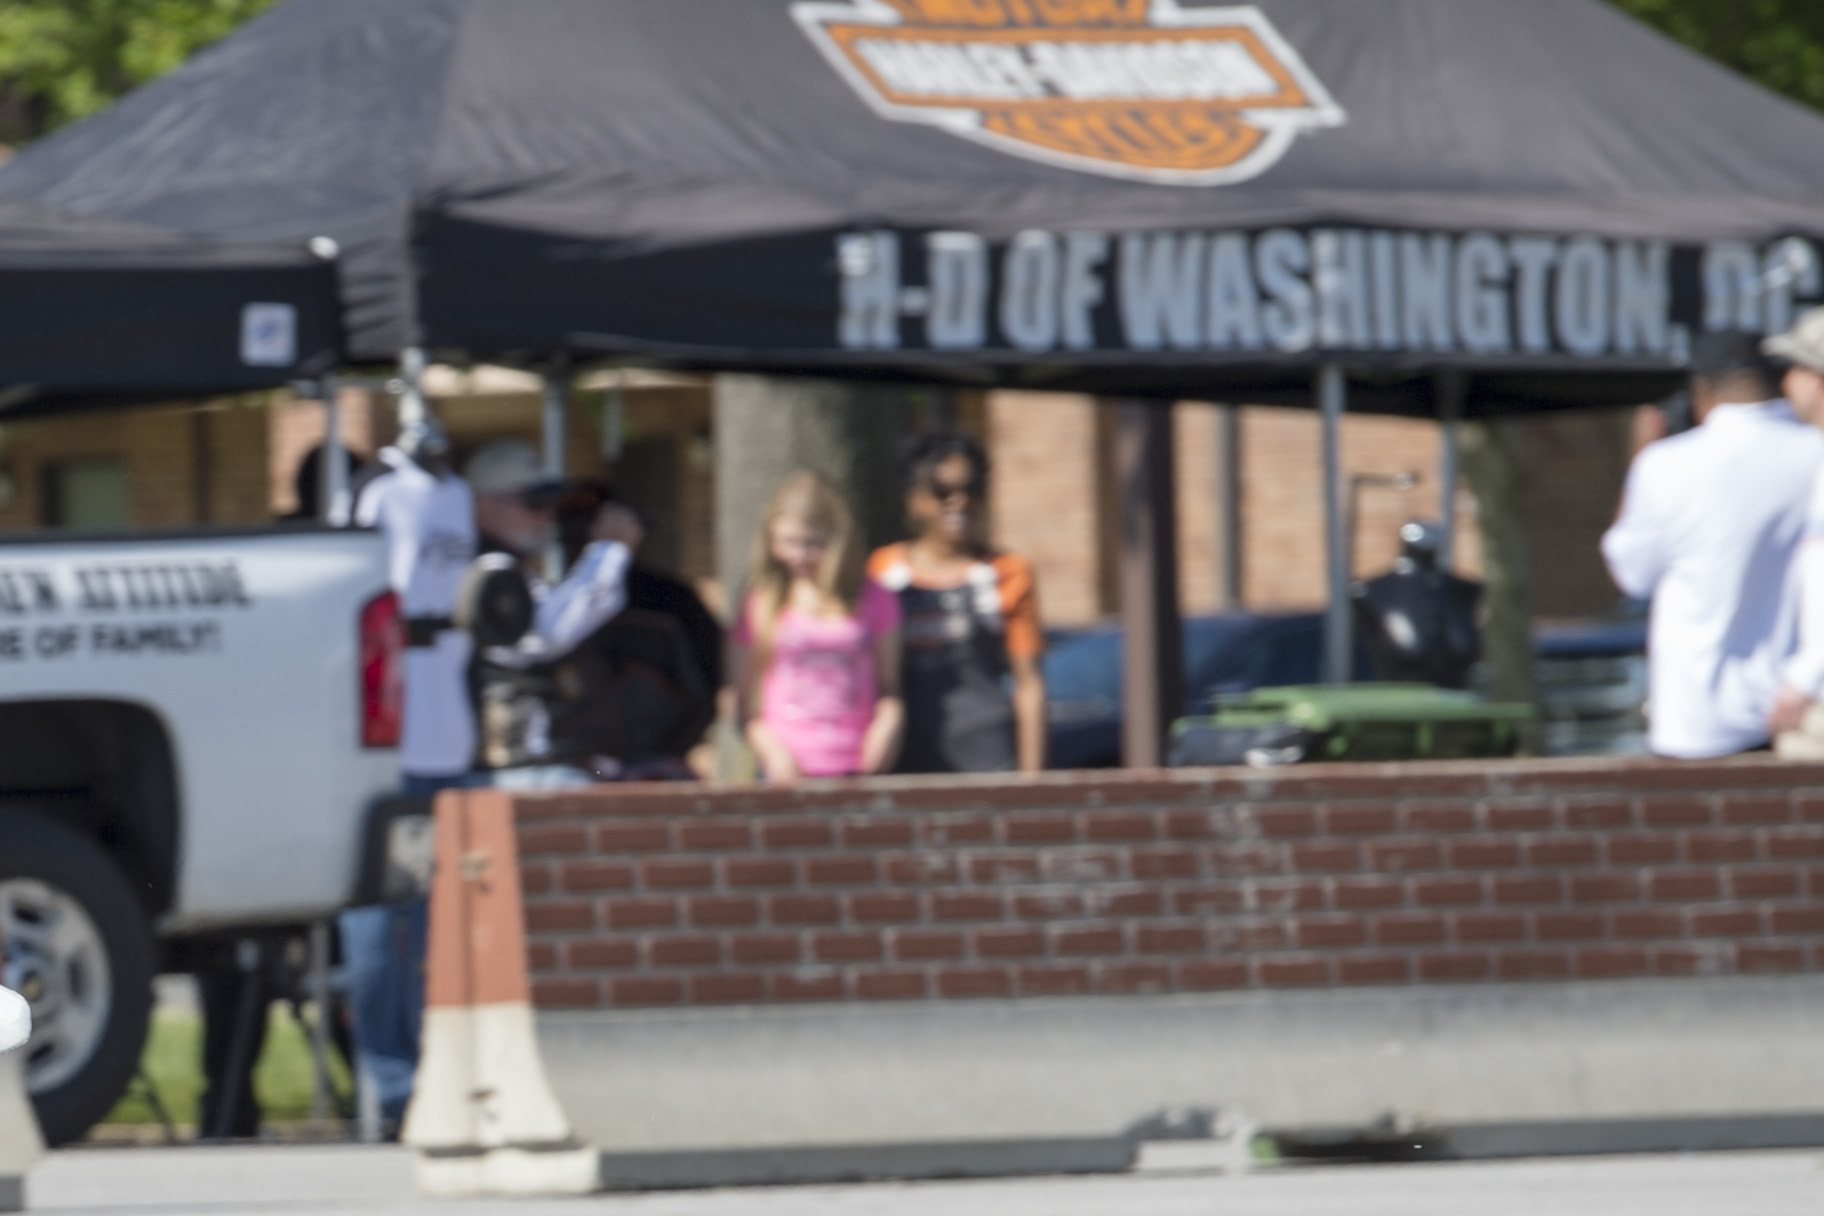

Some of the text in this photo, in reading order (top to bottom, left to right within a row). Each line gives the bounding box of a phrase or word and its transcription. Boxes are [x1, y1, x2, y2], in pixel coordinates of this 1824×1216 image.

[837, 231, 987, 350] H-D
[1000, 231, 1105, 351] OF
[33, 621, 80, 660] OF
